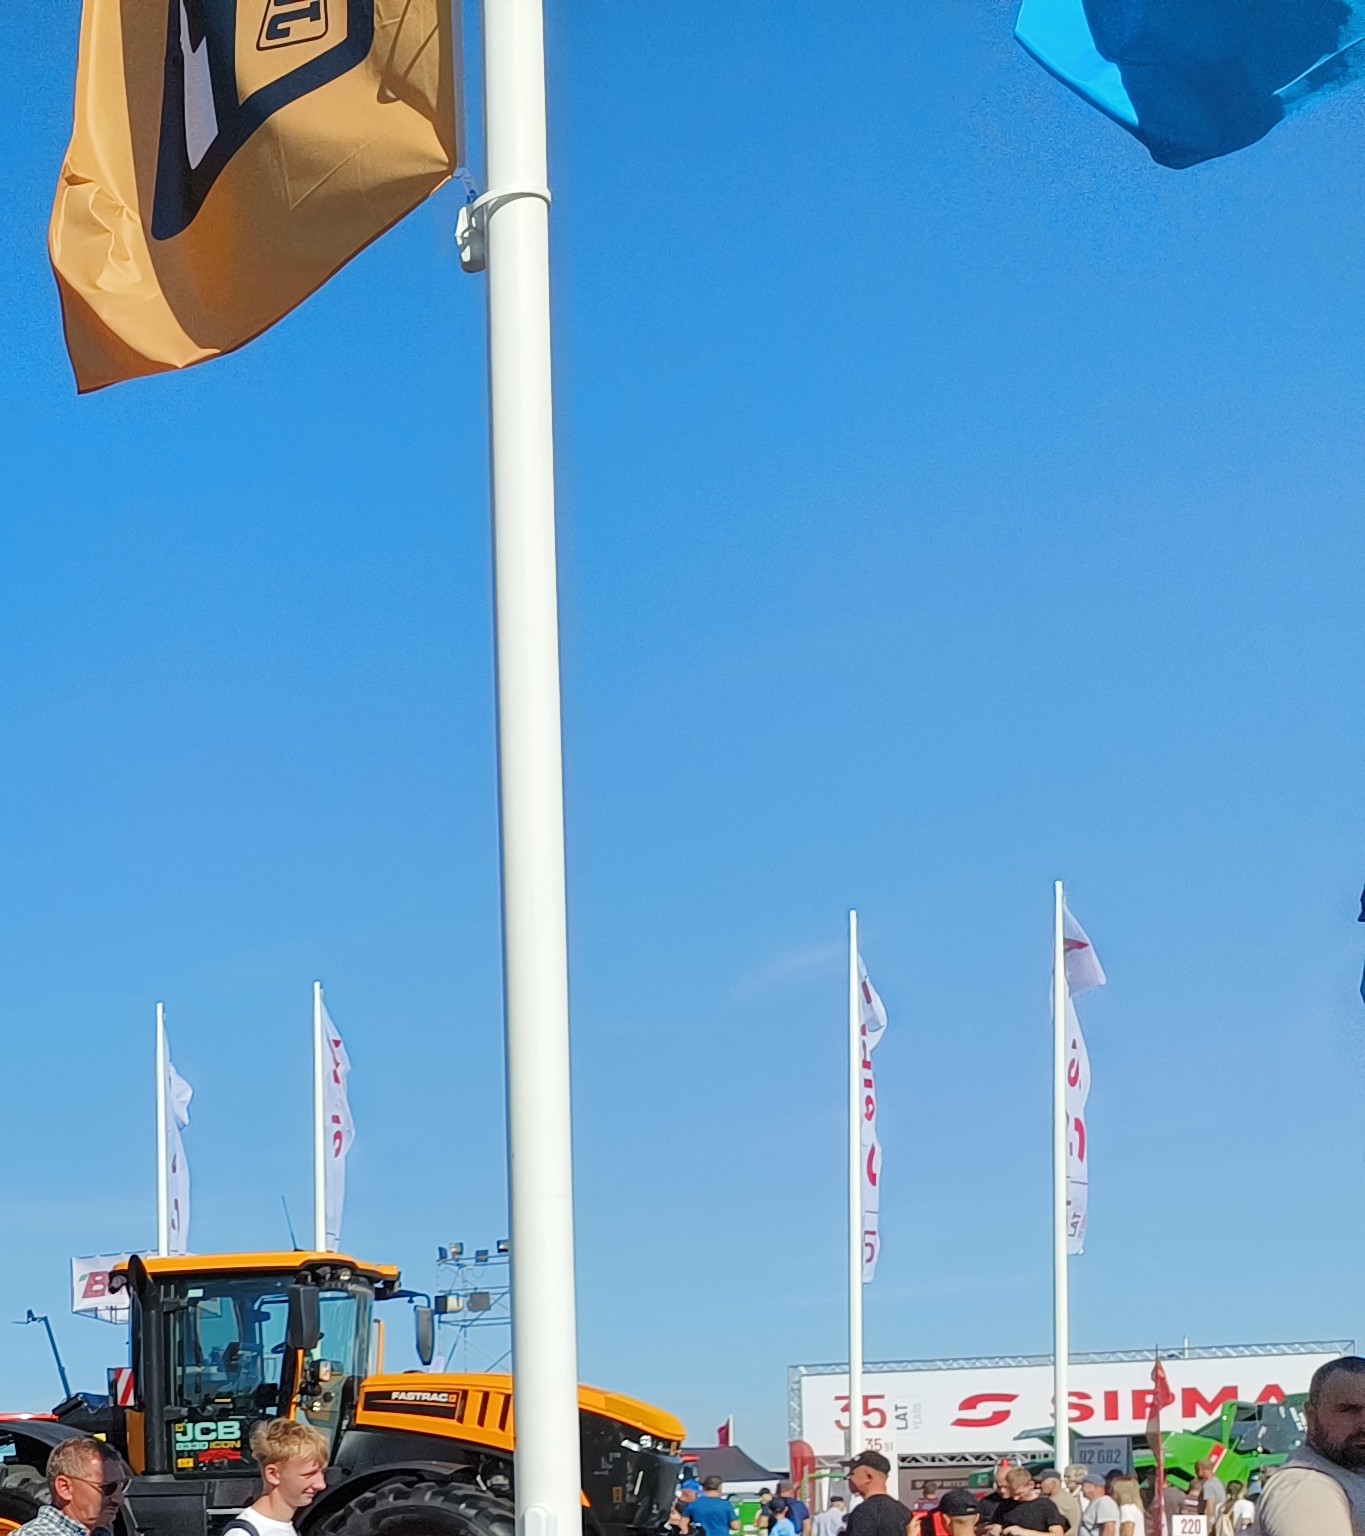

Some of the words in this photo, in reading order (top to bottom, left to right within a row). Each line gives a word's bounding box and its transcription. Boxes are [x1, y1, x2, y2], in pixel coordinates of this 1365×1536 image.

[391, 1391, 449, 1402] FASTRAC
[894, 1403, 909, 1431] LAT
[175, 1421, 241, 1441] JCB
[1181, 1518, 1201, 1535] 220
